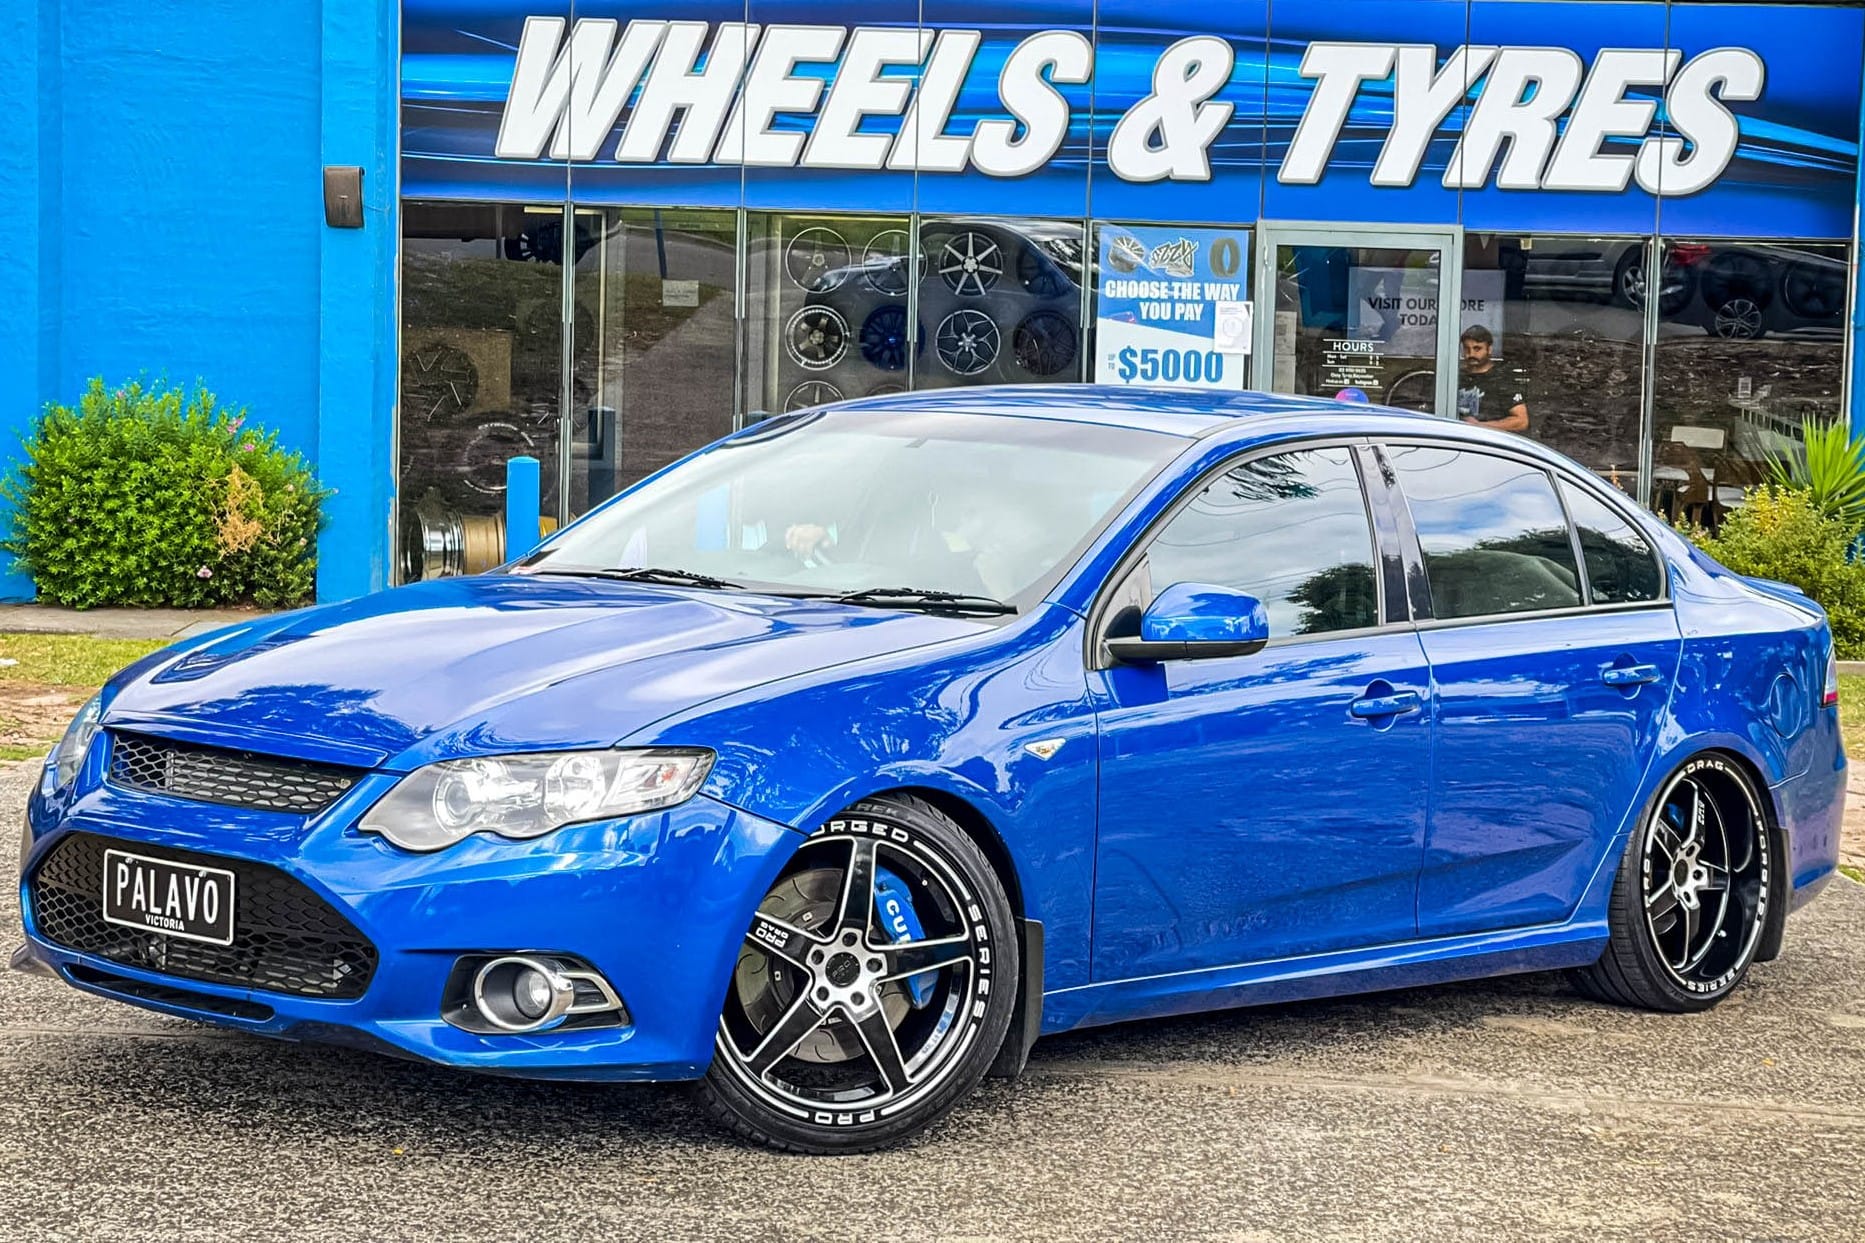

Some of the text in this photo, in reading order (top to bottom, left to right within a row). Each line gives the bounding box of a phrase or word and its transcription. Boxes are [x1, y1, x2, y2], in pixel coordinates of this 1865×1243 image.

[494, 16, 1765, 195] WHEELS & TYRES
[1105, 280, 1240, 301] CHOOSE THE WAY
[1139, 302, 1171, 320] YOU
[1174, 303, 1204, 321] PAY
[1368, 297, 1402, 310] VISIT
[1406, 298, 1437, 311] OUR
[1400, 313, 1437, 326] TODA
[1332, 341, 1374, 352] HOURS
[1118, 345, 1223, 384] $5000
[1687, 759, 1724, 774] DRAG
[810, 820, 909, 843] RGED
[116, 862, 219, 924] PALAVO
[145, 913, 185, 931] VICTORIA
[760, 921, 789, 940] DRAG
[755, 927, 786, 948] PRO
[968, 904, 991, 1018] SERIES
[1687, 967, 1735, 992] SERIES
[814, 1109, 875, 1125] PRO
